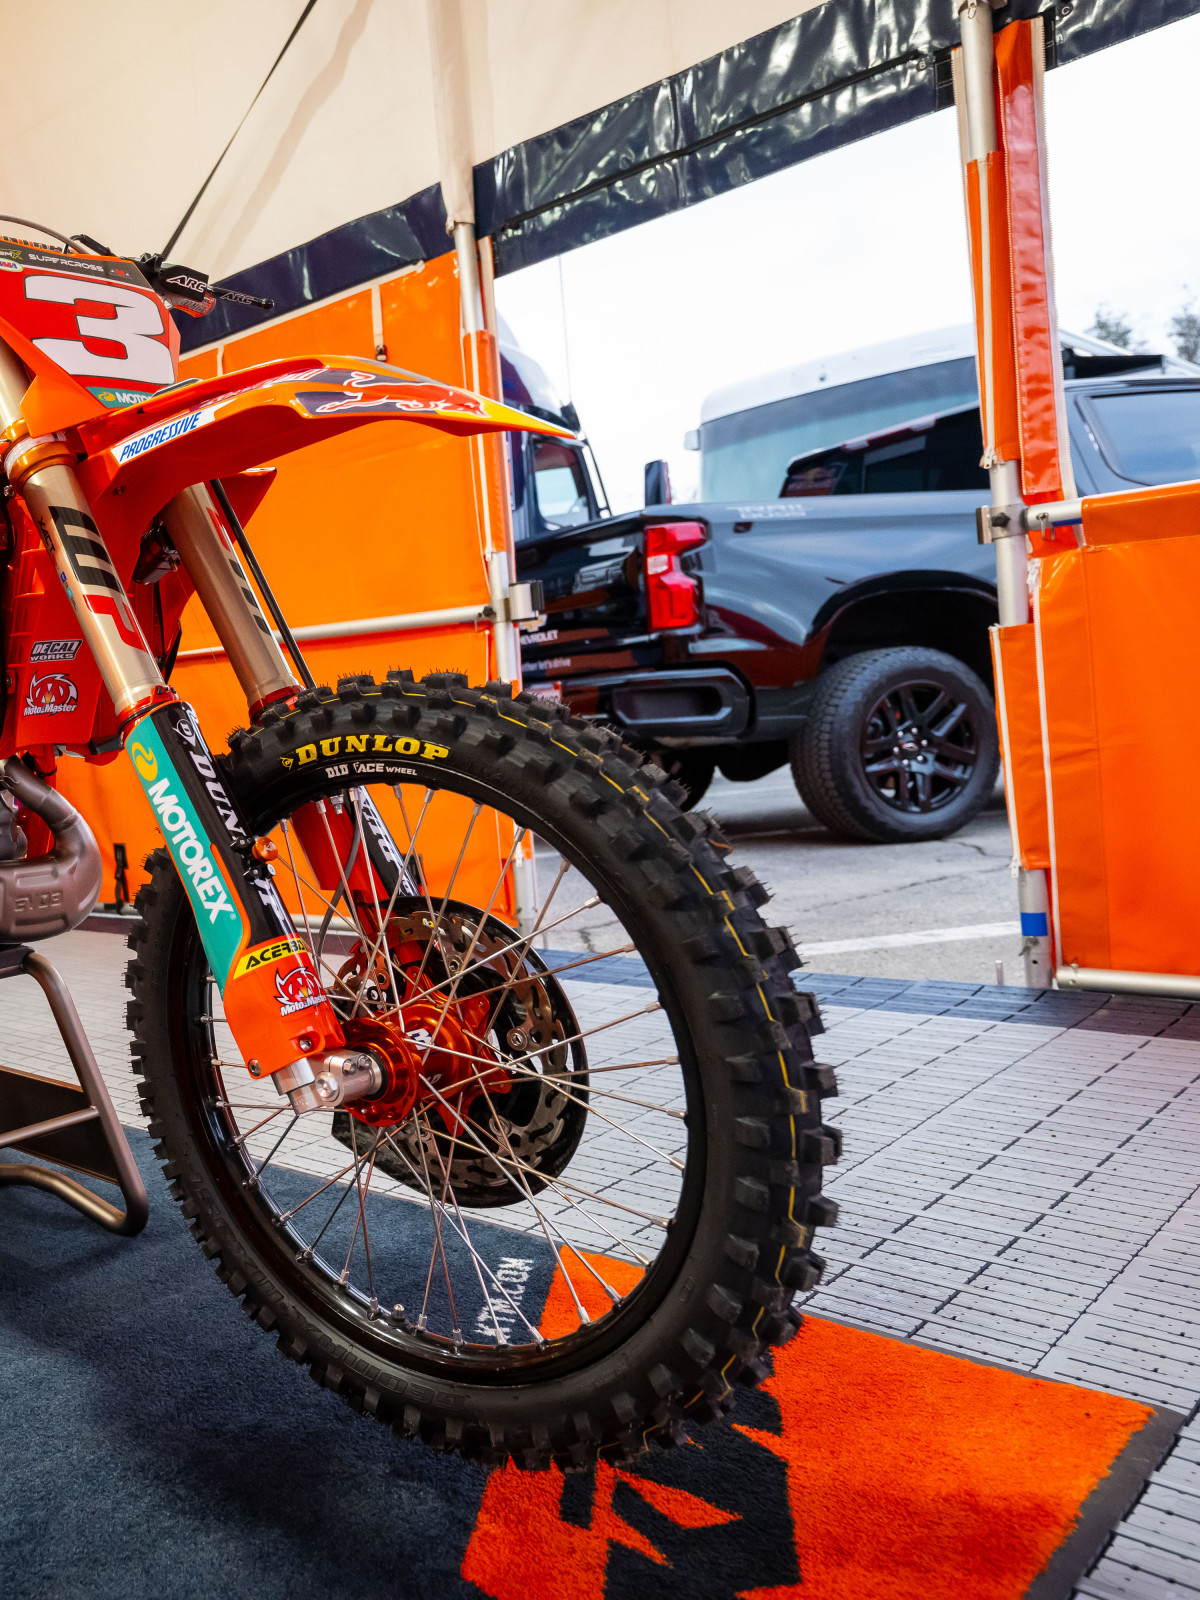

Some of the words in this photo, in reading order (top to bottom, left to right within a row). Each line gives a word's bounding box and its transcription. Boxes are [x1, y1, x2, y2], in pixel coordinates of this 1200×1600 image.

[28, 253, 104, 272] SUPERCROSS
[166, 275, 207, 293] ARC
[220, 292, 255, 305] ARC
[23, 274, 176, 386] 3
[119, 411, 202, 462] PROGRESSIVE
[33, 640, 81, 655] DECAL
[30, 653, 75, 662] WORKS
[295, 734, 450, 766] DUNLOP
[325, 764, 350, 779] DID
[385, 765, 418, 776] WHEEL
[147, 777, 235, 924] MOTOREX
